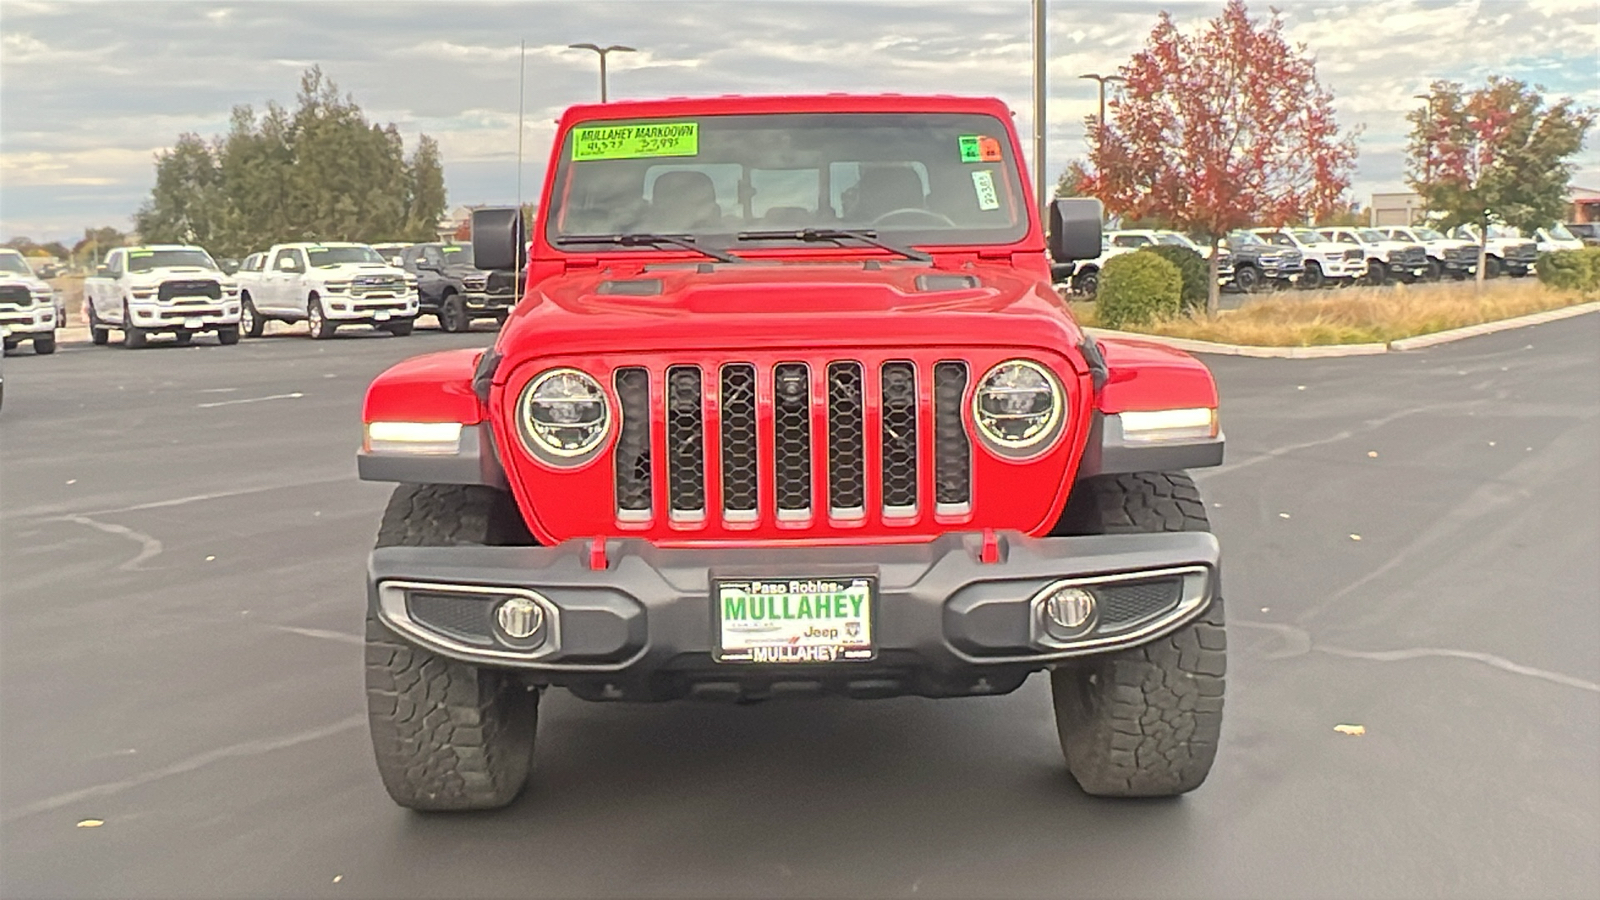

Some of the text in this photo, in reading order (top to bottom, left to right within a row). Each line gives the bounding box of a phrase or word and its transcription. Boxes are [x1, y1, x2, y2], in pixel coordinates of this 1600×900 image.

[581, 125, 694, 141] MULLAHEY MARKDOWN
[752, 582, 787, 594] Paso
[789, 580, 838, 593] Robles
[725, 594, 865, 620] MULLAHEY
[804, 626, 838, 640] Jeep
[752, 645, 840, 662] MULLAHEY
